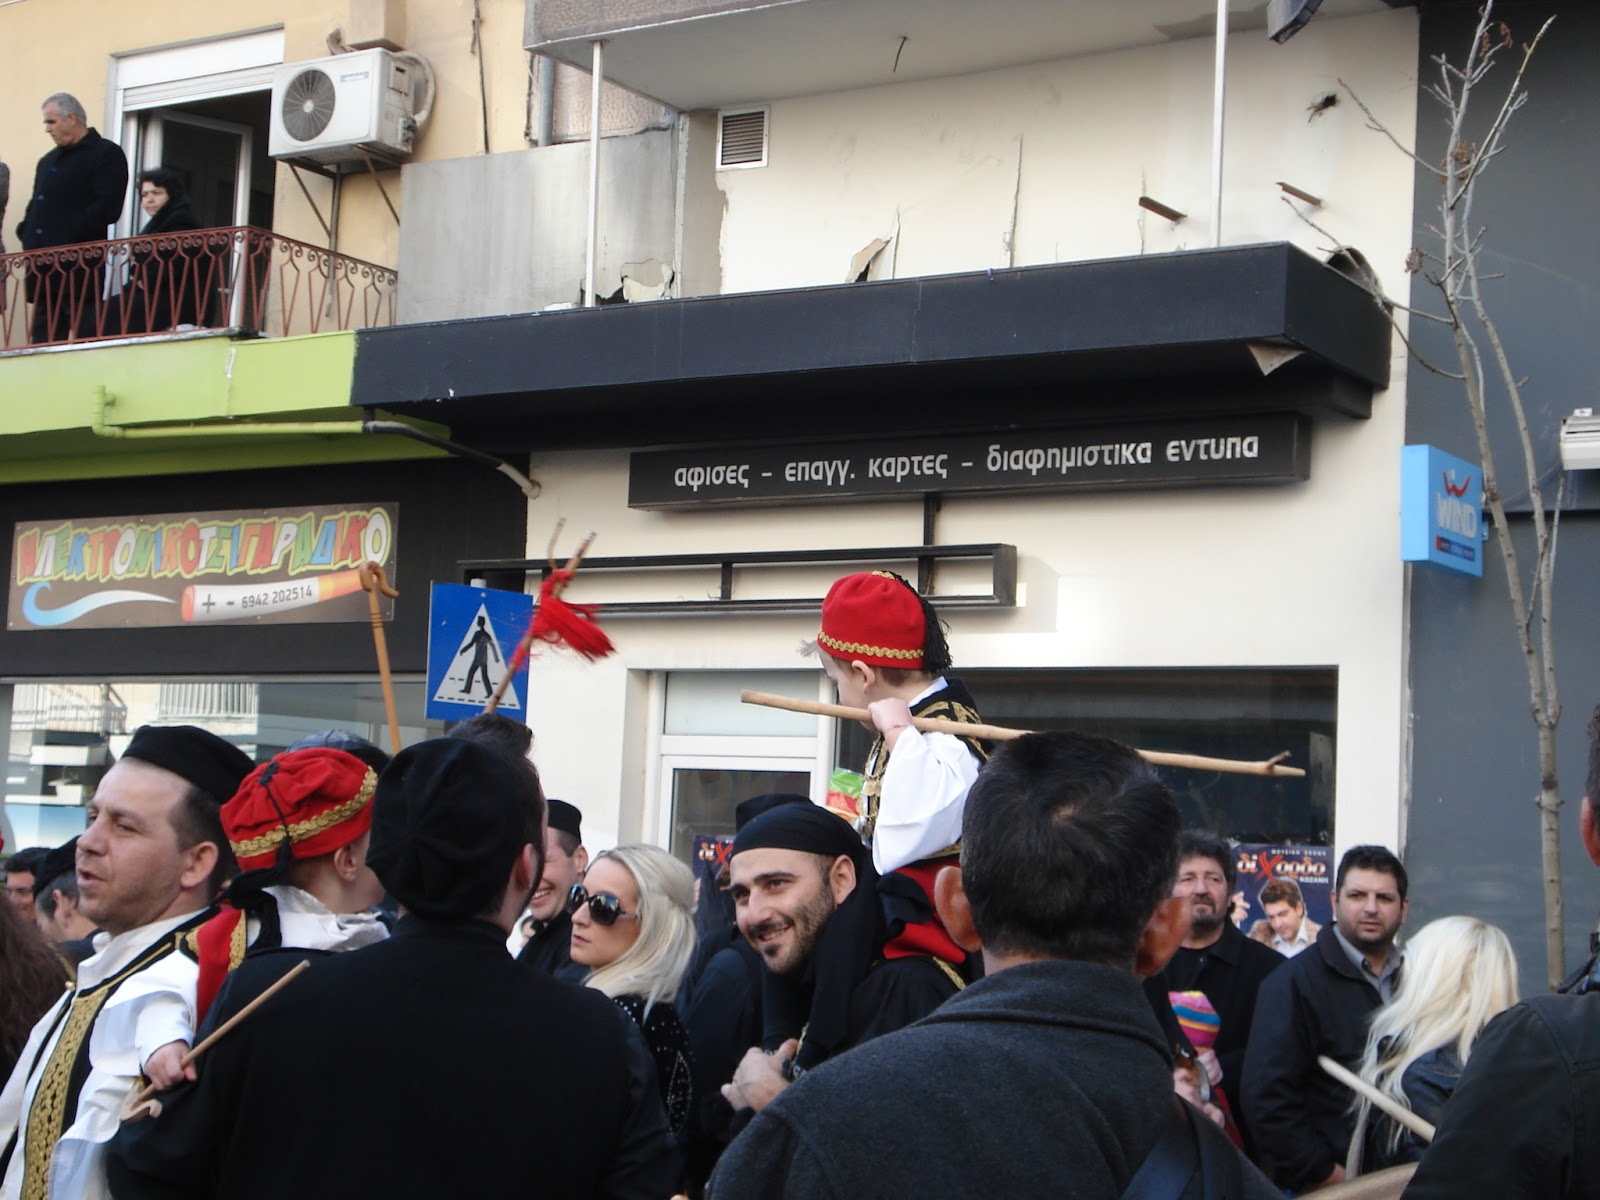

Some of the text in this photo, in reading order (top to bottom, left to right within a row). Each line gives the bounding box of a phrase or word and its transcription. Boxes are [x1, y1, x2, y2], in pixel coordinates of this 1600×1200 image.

[674, 464, 750, 492] αφισες
[784, 459, 856, 487] επαγγ.
[868, 454, 948, 483] καρτες
[986, 441, 1152, 476] διαφημιστικα
[1165, 435, 1259, 462] εντυπα
[241, 594, 269, 609] 6942
[272, 586, 313, 605] 202514
